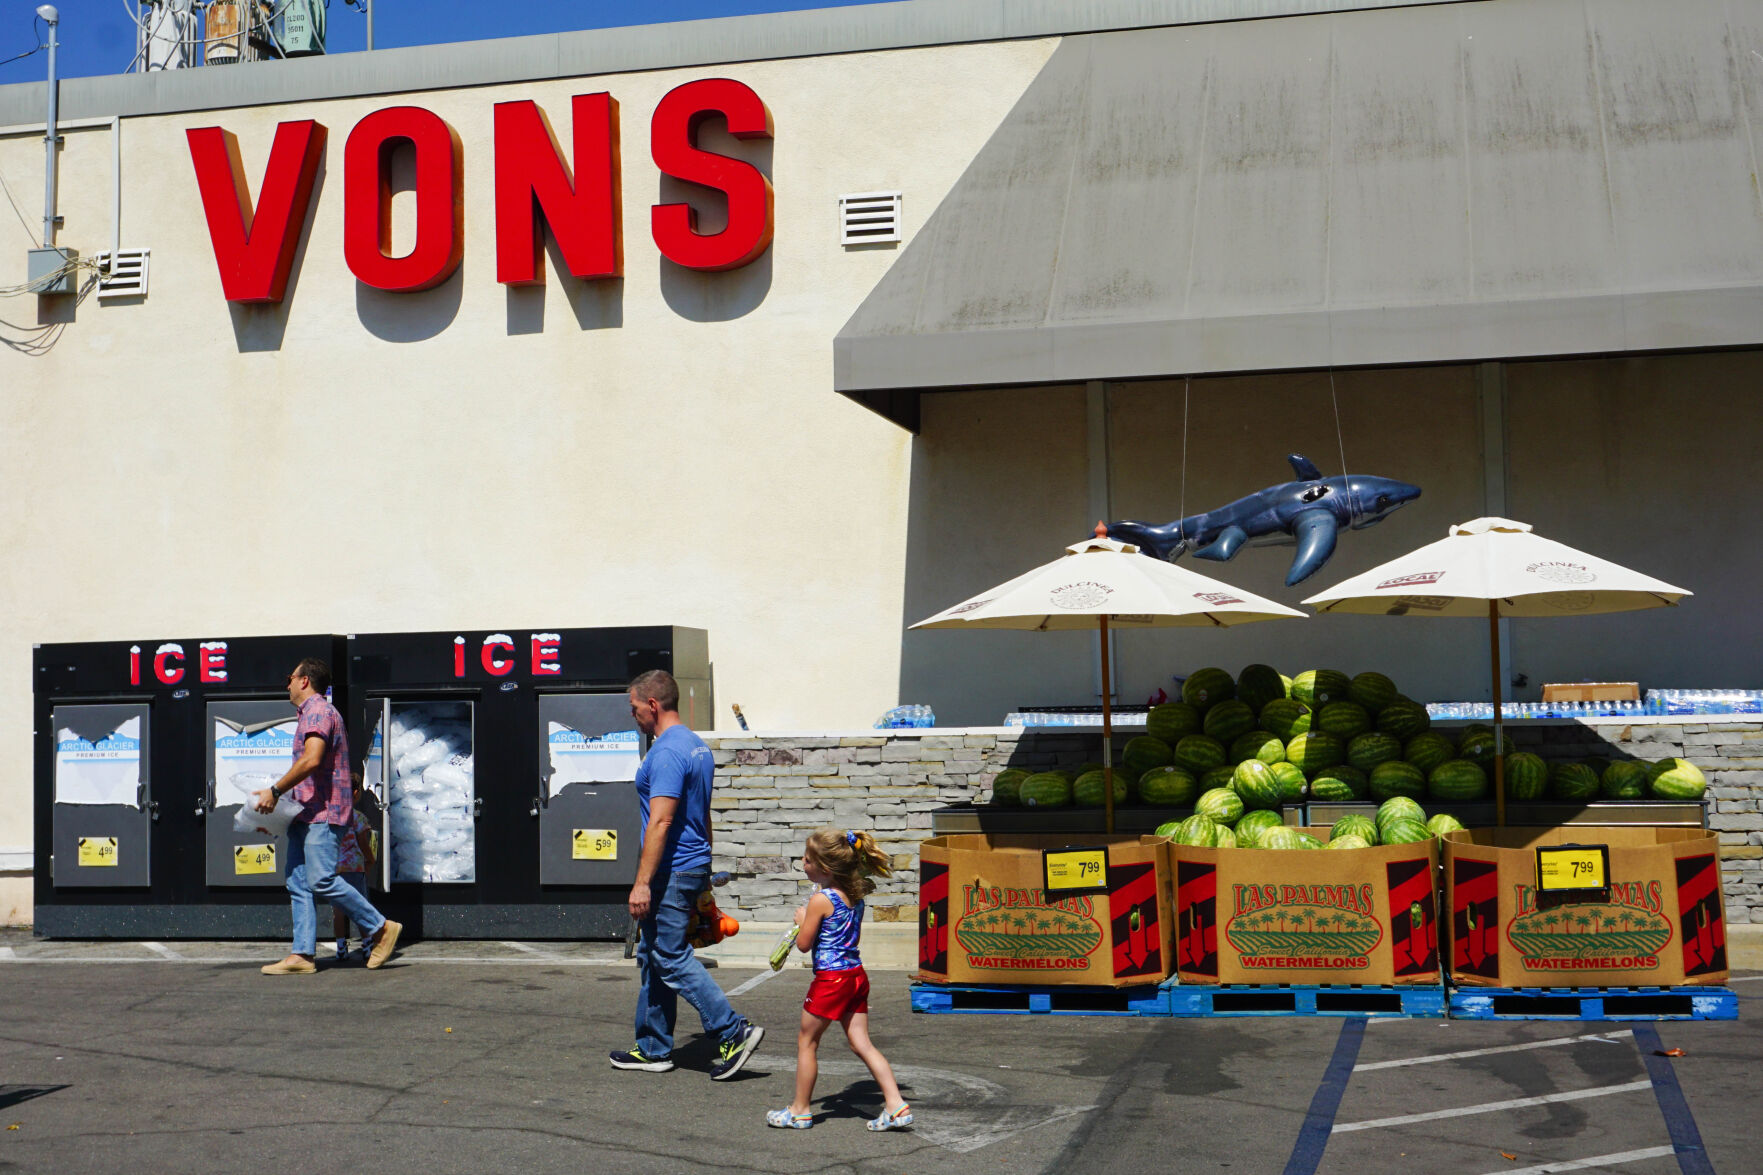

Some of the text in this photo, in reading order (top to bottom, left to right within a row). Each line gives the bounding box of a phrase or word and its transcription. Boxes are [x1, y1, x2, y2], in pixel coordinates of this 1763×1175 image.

[186, 78, 774, 304] VONS
[454, 633, 562, 678] ICE
[130, 641, 229, 686] ICE
[221, 738, 254, 748] ARCTIC
[554, 732, 637, 743] ARCTI LACIER
[95, 741, 135, 751] GLACIER
[963, 885, 1001, 918] LAS
[1233, 883, 1373, 918] LAS PALMAS
[1017, 945, 1070, 958] California
[1291, 945, 1350, 957] California
[1577, 946, 1639, 959] California
[967, 955, 1090, 970] WATERMELONS
[1240, 955, 1369, 968] WATERMELONS
[1523, 955, 1659, 970] WATERMELONS
